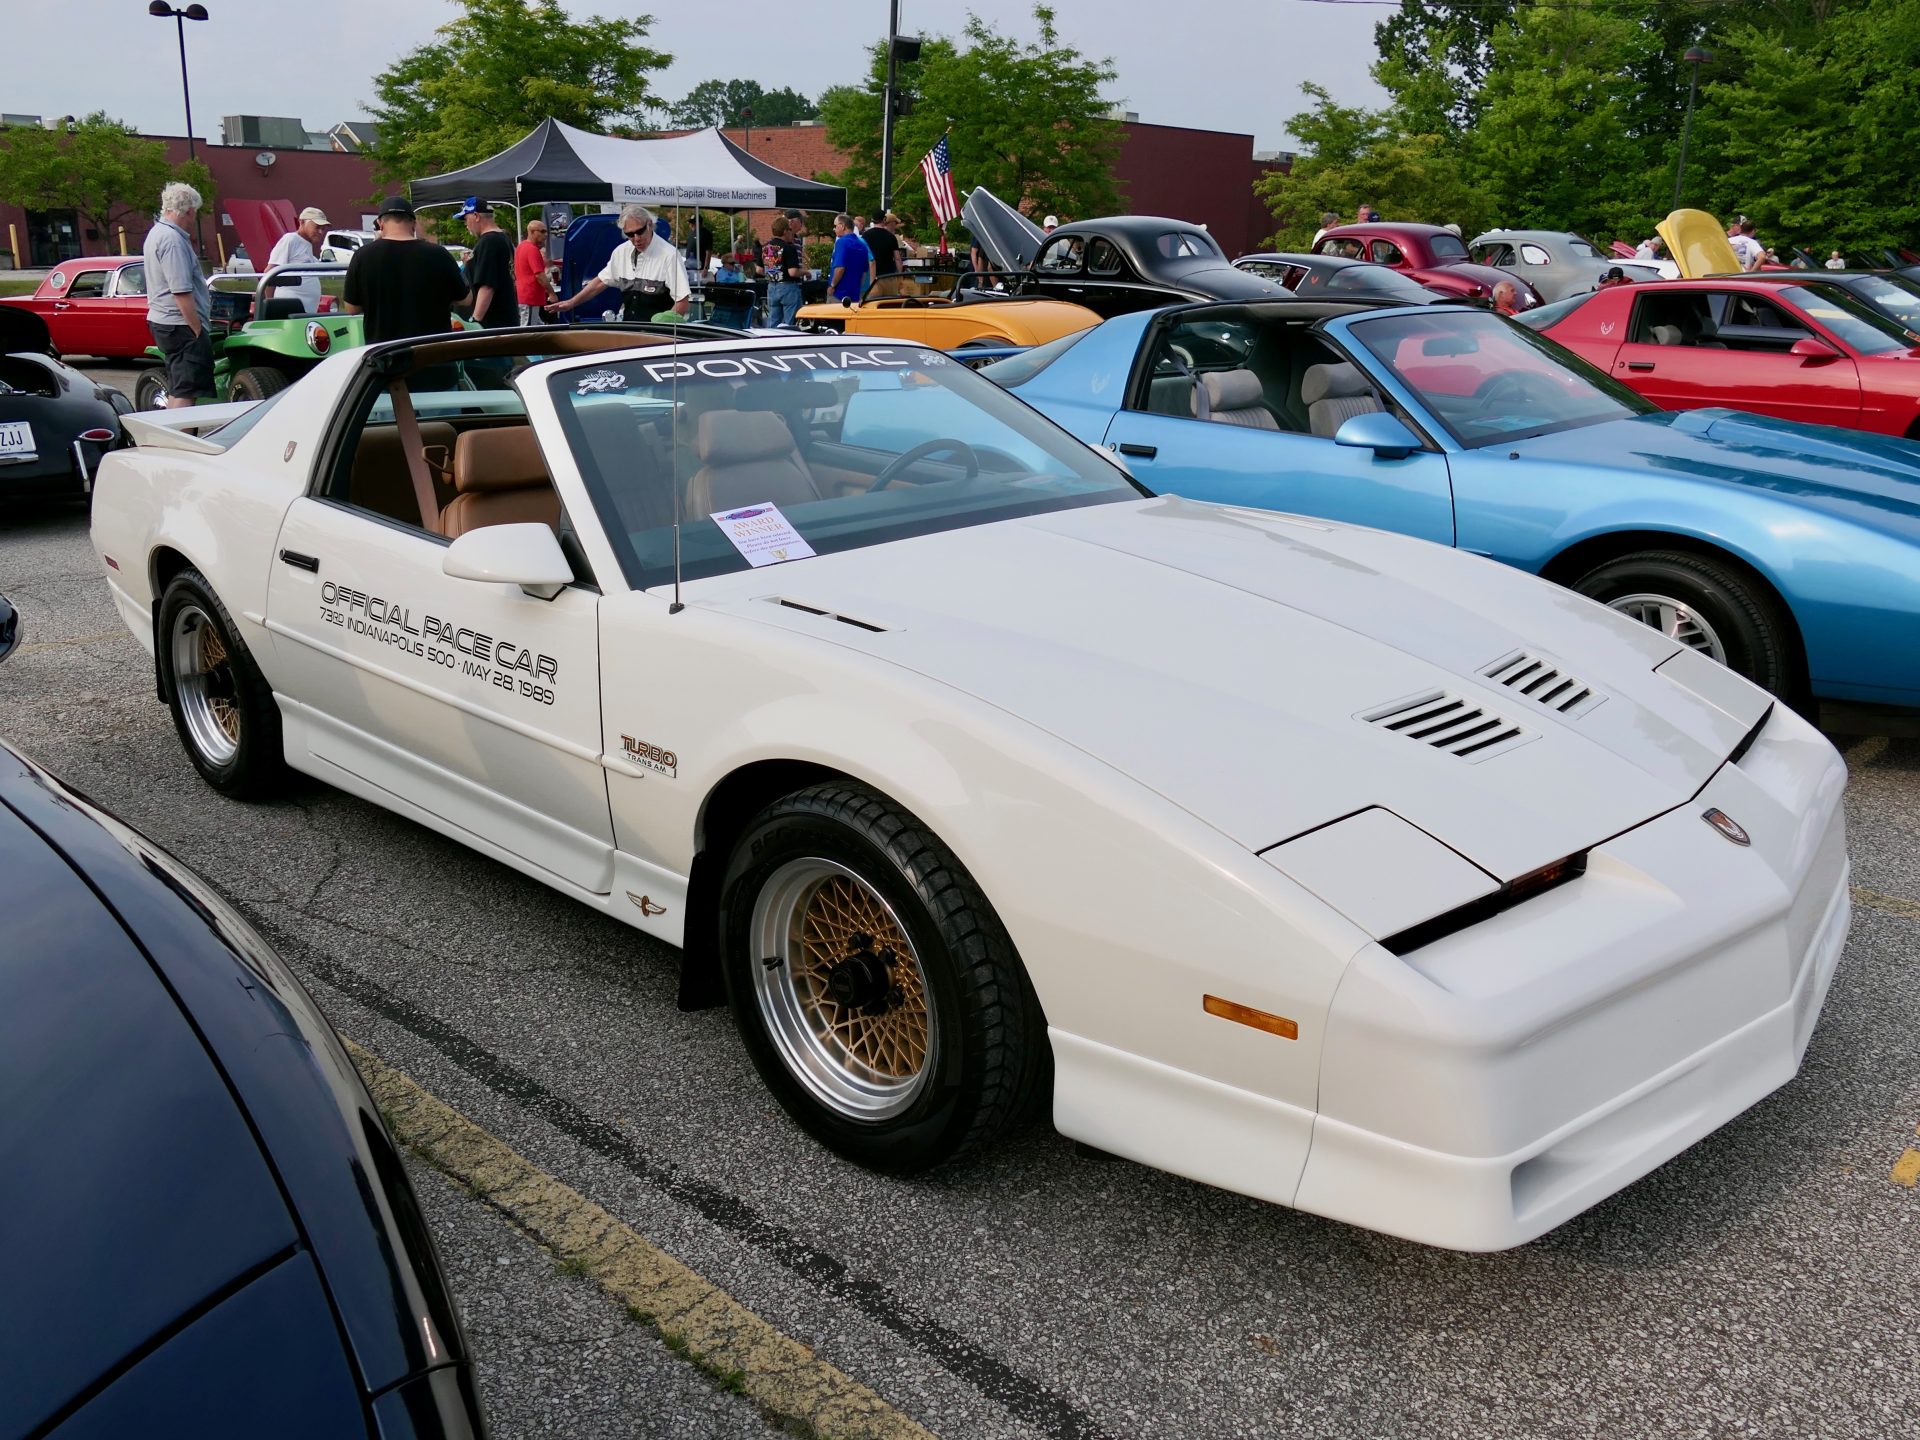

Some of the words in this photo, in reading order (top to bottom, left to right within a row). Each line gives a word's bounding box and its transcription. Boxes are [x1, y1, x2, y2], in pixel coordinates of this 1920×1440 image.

[624, 185, 675, 197] Rock-N-Roll
[677, 187, 705, 200] Capital
[707, 189, 730, 200] Street
[732, 190, 767, 201] Machines
[643, 350, 909, 383] PONTIAC
[733, 517, 774, 531] AWARD
[734, 524, 784, 537] WINNER
[321, 581, 420, 637] OFFICIAL
[422, 615, 494, 662] PACE
[495, 641, 558, 686] CAR
[319, 606, 345, 628] 73RD
[347, 616, 425, 658] INDIANAPOLIS
[427, 646, 456, 669] 500
[461, 660, 492, 682] MAY
[518, 679, 555, 706] 1989
[620, 734, 677, 768] TURBO
[626, 752, 653, 768] TRANS
[653, 763, 668, 774] AM
